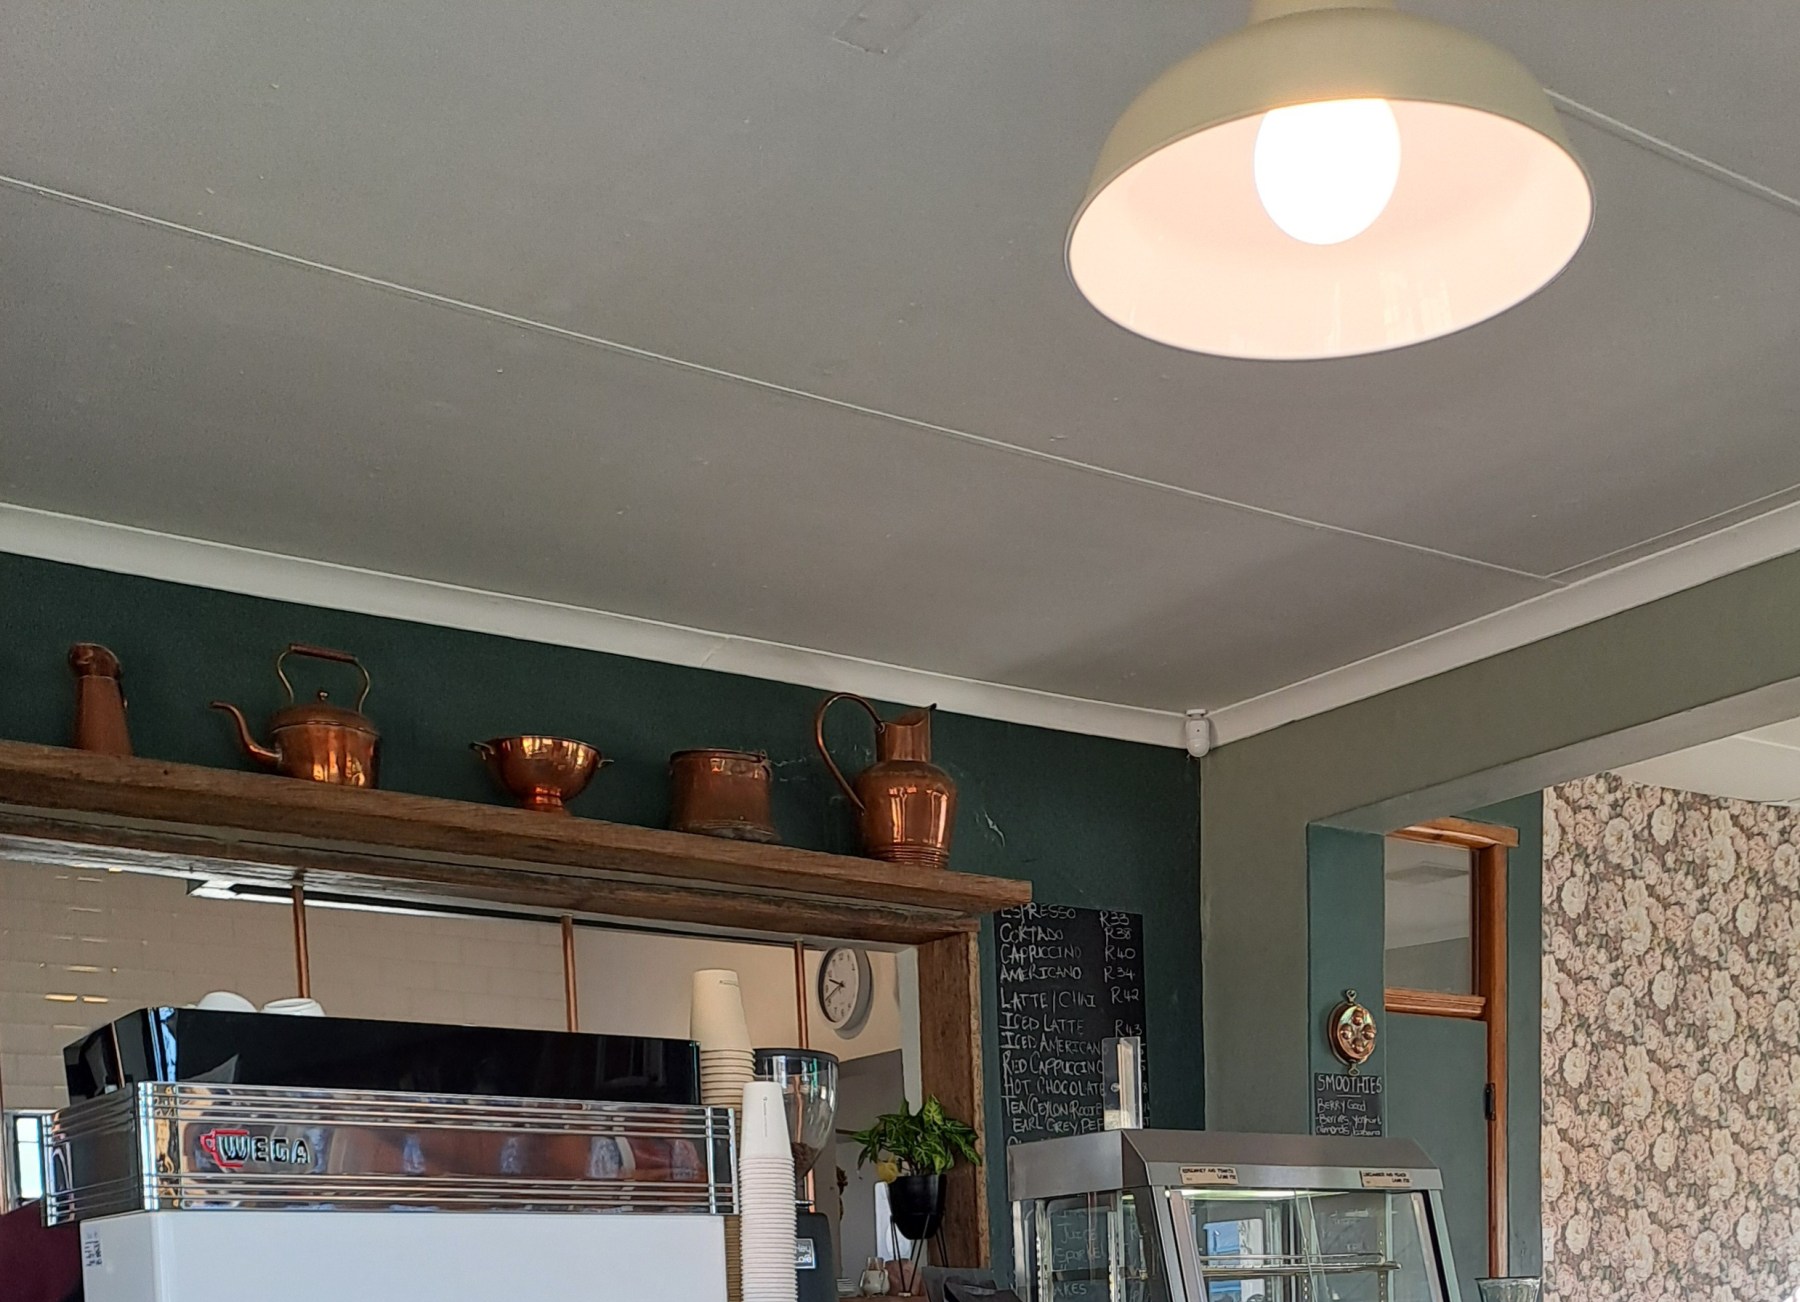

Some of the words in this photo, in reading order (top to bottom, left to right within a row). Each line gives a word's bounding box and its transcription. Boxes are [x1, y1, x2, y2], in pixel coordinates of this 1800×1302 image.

[1000, 902, 1076, 922] ESPRESSO
[1100, 911, 1130, 927] R33
[1104, 928, 1132, 945] R38
[1000, 944, 1082, 965] CAPPUCCINO
[1105, 946, 1136, 962] R40
[1000, 964, 1082, 983] AMERICANO
[1111, 986, 1139, 1004] R42
[1000, 1012, 1039, 1031] ICED
[1043, 1013, 1084, 1035] LATTE
[1115, 1019, 1142, 1037] R43
[1000, 1032, 1037, 1049] ICED
[1003, 1050, 1027, 1076] RED
[1004, 1074, 1030, 1097] HOT
[1317, 1074, 1383, 1094] SMOOTHIES
[1317, 1098, 1346, 1114] BERRY
[1012, 1115, 1043, 1132] EARL
[217, 1135, 311, 1164] WEGA
